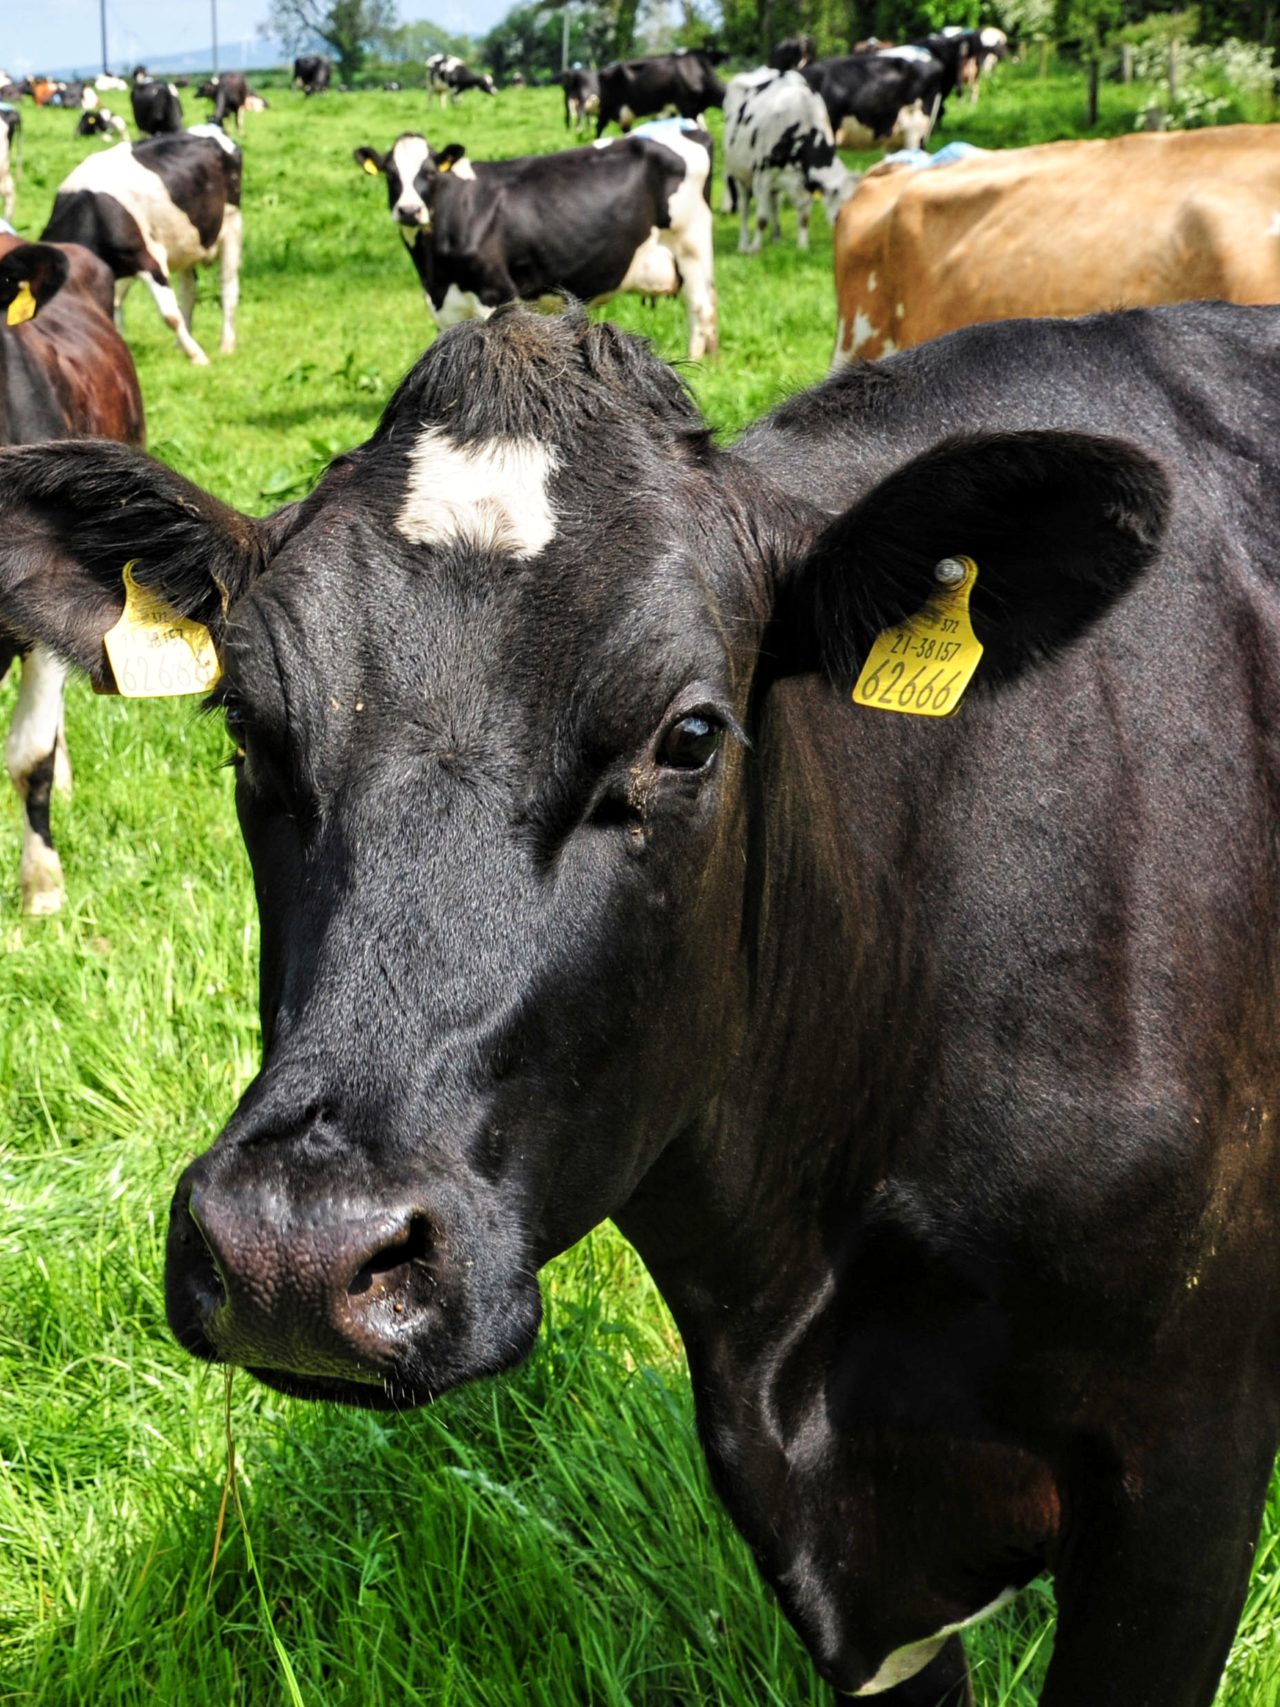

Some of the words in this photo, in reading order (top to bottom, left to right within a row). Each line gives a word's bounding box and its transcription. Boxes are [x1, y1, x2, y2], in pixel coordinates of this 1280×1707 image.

[940, 618, 960, 634] 372
[890, 633, 962, 662] 21-38157
[861, 658, 963, 710] 62666
